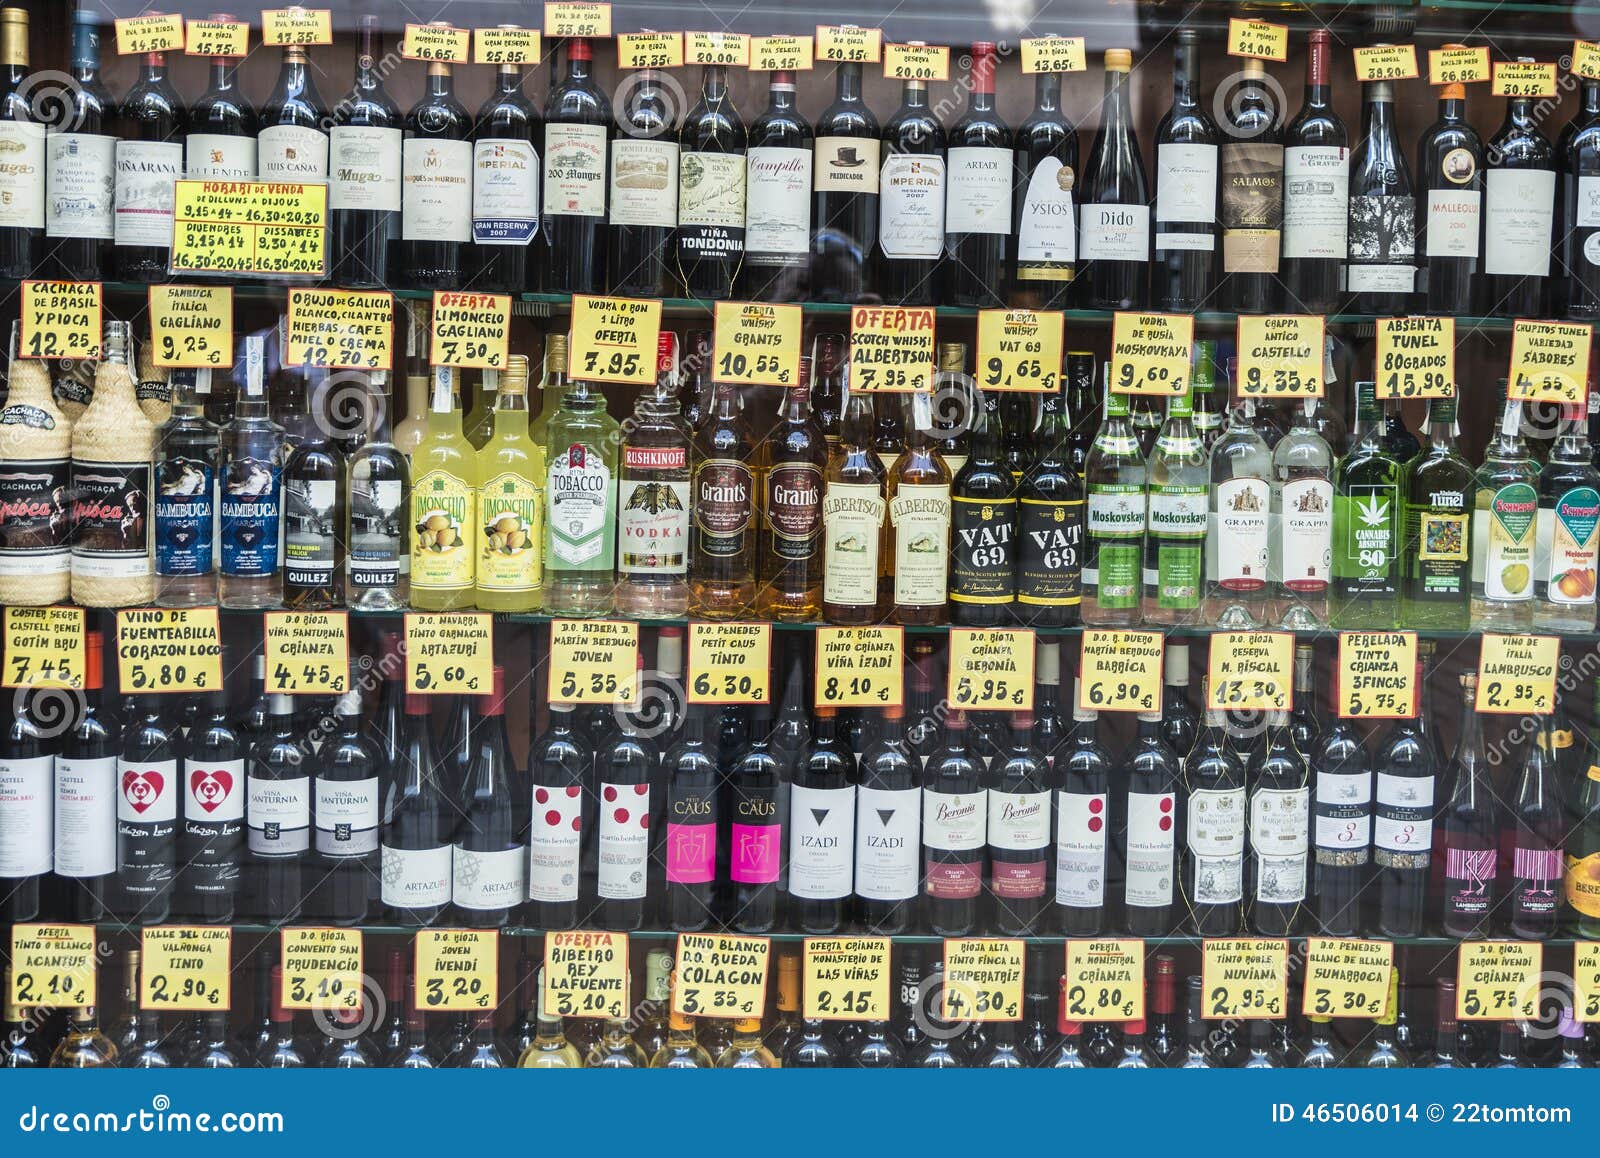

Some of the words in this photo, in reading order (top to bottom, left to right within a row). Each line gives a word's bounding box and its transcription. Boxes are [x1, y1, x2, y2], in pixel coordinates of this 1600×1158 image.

[338, 169, 380, 182] Muga
[566, 169, 600, 180] Monges
[890, 177, 939, 186] IMPERIAL
[1233, 177, 1275, 187] SALMOS
[204, 182, 250, 195] HORARI
[268, 184, 304, 194] VENDA
[209, 195, 247, 204] DILLUNS
[262, 196, 299, 206] DIJOUS
[1032, 202, 1068, 216] YSIOS
[1101, 211, 1133, 225] Dido
[493, 222, 528, 230] RESERVA
[701, 227, 728, 238] VIÑA
[682, 238, 743, 250] TONDONIA
[34, 298, 46, 307] DE
[51, 297, 98, 309] BRASIL
[348, 296, 390, 308] GALICIA
[440, 294, 497, 310] OFERTA
[589, 301, 617, 311] VODKA
[35, 312, 89, 326] YPIOCA
[855, 310, 933, 332] OFERTA
[1139, 317, 1167, 326] VODKA
[348, 324, 384, 335] CAFE
[437, 325, 503, 338] GAGLIANO
[1387, 320, 1442, 331] ABSENTA
[1516, 324, 1556, 334] CHUPITOS
[1559, 328, 1588, 336] TUNEL
[291, 334, 322, 346] MIEL
[340, 337, 385, 350] CREMA
[595, 330, 637, 344] OFERTA
[734, 333, 782, 346] GRANTS
[851, 333, 889, 345] SCOTCH
[1392, 335, 1438, 348] TUNEL
[1529, 337, 1573, 348] VARIEDAD
[1000, 341, 1020, 352] VAT
[1025, 341, 1041, 353] 69
[1252, 348, 1310, 358] CASTELLO
[853, 349, 933, 364] ALBERTSON
[1523, 352, 1577, 366] SABORES
[627, 451, 684, 464] RUSHKINOFF
[554, 476, 603, 491] TOBACCO
[1093, 511, 1144, 523] Moskovskaya
[1153, 512, 1206, 524] Moskovskaya
[626, 527, 681, 538] VODKA
[959, 523, 1011, 548] VAT
[1030, 524, 1081, 549] VAT
[1356, 530, 1390, 540] CANNABIS
[1358, 540, 1387, 549] ABSINTHE
[1359, 550, 1385, 567] 80
[289, 573, 328, 583] QUILEZ
[355, 573, 394, 584] QUILEZ
[12, 610, 46, 621] COSTER
[50, 610, 78, 620] SEGRE
[126, 612, 163, 622] VINO
[171, 612, 187, 621] DE
[440, 616, 478, 626] NAVARRA
[10, 623, 50, 631] CASTELL
[121, 627, 216, 640] FUENTEABILLA
[440, 629, 487, 640] GARNACHA
[54, 639, 77, 651] BRU
[592, 637, 637, 648] BERDUGO
[730, 639, 755, 648] CAUS
[1348, 635, 1406, 649] PERELADA
[120, 645, 186, 660] CORAZON
[190, 645, 220, 656] LOCO
[572, 652, 612, 663] JOVEN
[1233, 648, 1269, 657] RESERVA
[1356, 650, 1389, 660] TINTO
[1350, 661, 1398, 672] CRIANZA
[1484, 665, 1552, 677] LAMBRUSCO
[675, 801, 711, 814] CAUS
[739, 802, 775, 815] CAUS
[936, 804, 975, 820] Beronia
[1001, 804, 1040, 821] Beronia
[801, 836, 837, 847] IZADI
[867, 835, 904, 848] IZADI
[38, 928, 70, 938] OFERTA
[179, 930, 198, 938] DEL
[202, 930, 230, 940] CINCA
[554, 934, 613, 948] OFERTA
[683, 935, 713, 948] VINO
[719, 940, 767, 953] BLANCO
[810, 942, 842, 952] OFERTA
[989, 943, 1009, 951] ALTA
[1206, 943, 1231, 951] VALLE
[1235, 942, 1252, 950] DEL
[287, 945, 336, 953] CONVENTO
[340, 946, 358, 954] SAN
[1090, 943, 1120, 953] OFERTA
[552, 948, 613, 962] RIBEIRO
[711, 953, 758, 966] RUEDA
[1310, 954, 1340, 963] BLANC
[1344, 956, 1356, 964] DE
[1359, 957, 1390, 966] BLANC
[26, 957, 86, 967] ACANTUS
[170, 958, 203, 969] TINTO
[568, 964, 598, 978] REY
[683, 967, 763, 985] COLAGON
[817, 969, 840, 981] LAS
[1315, 969, 1383, 983] SUMARROCA
[550, 978, 622, 990] LAFUENTE
[901, 986, 919, 1003] 89
